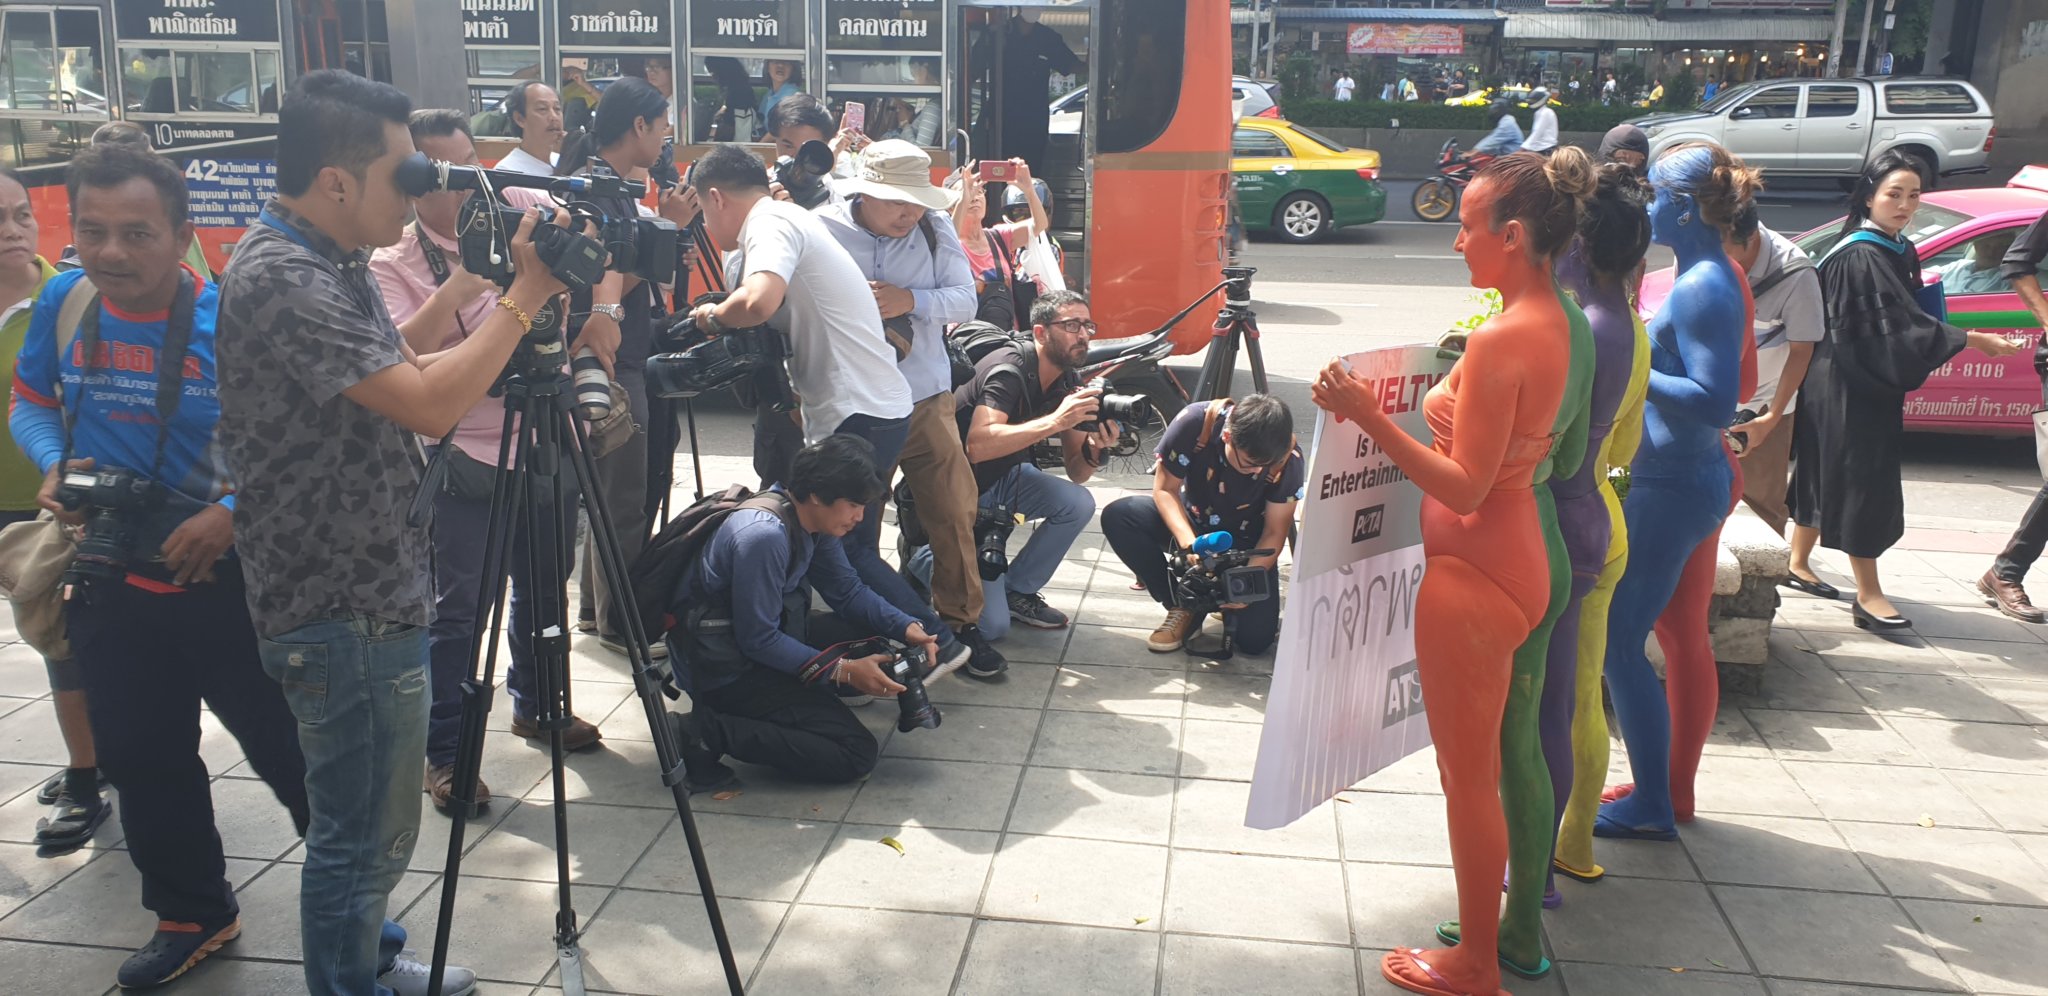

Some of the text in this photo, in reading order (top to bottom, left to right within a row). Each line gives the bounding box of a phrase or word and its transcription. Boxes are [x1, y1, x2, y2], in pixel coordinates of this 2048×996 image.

[148, 11, 238, 35] พาณิชย์ธน
[463, 16, 508, 39] พาต้า
[569, 9, 659, 33] ราชดำเนิน
[717, 13, 778, 42] พาหุรัด
[838, 17, 928, 37] คลองสาน
[154, 123, 173, 146] 10
[184, 158, 220, 181] 42
[1355, 434, 1369, 459] Is
[1320, 461, 1409, 500] Entertainm
